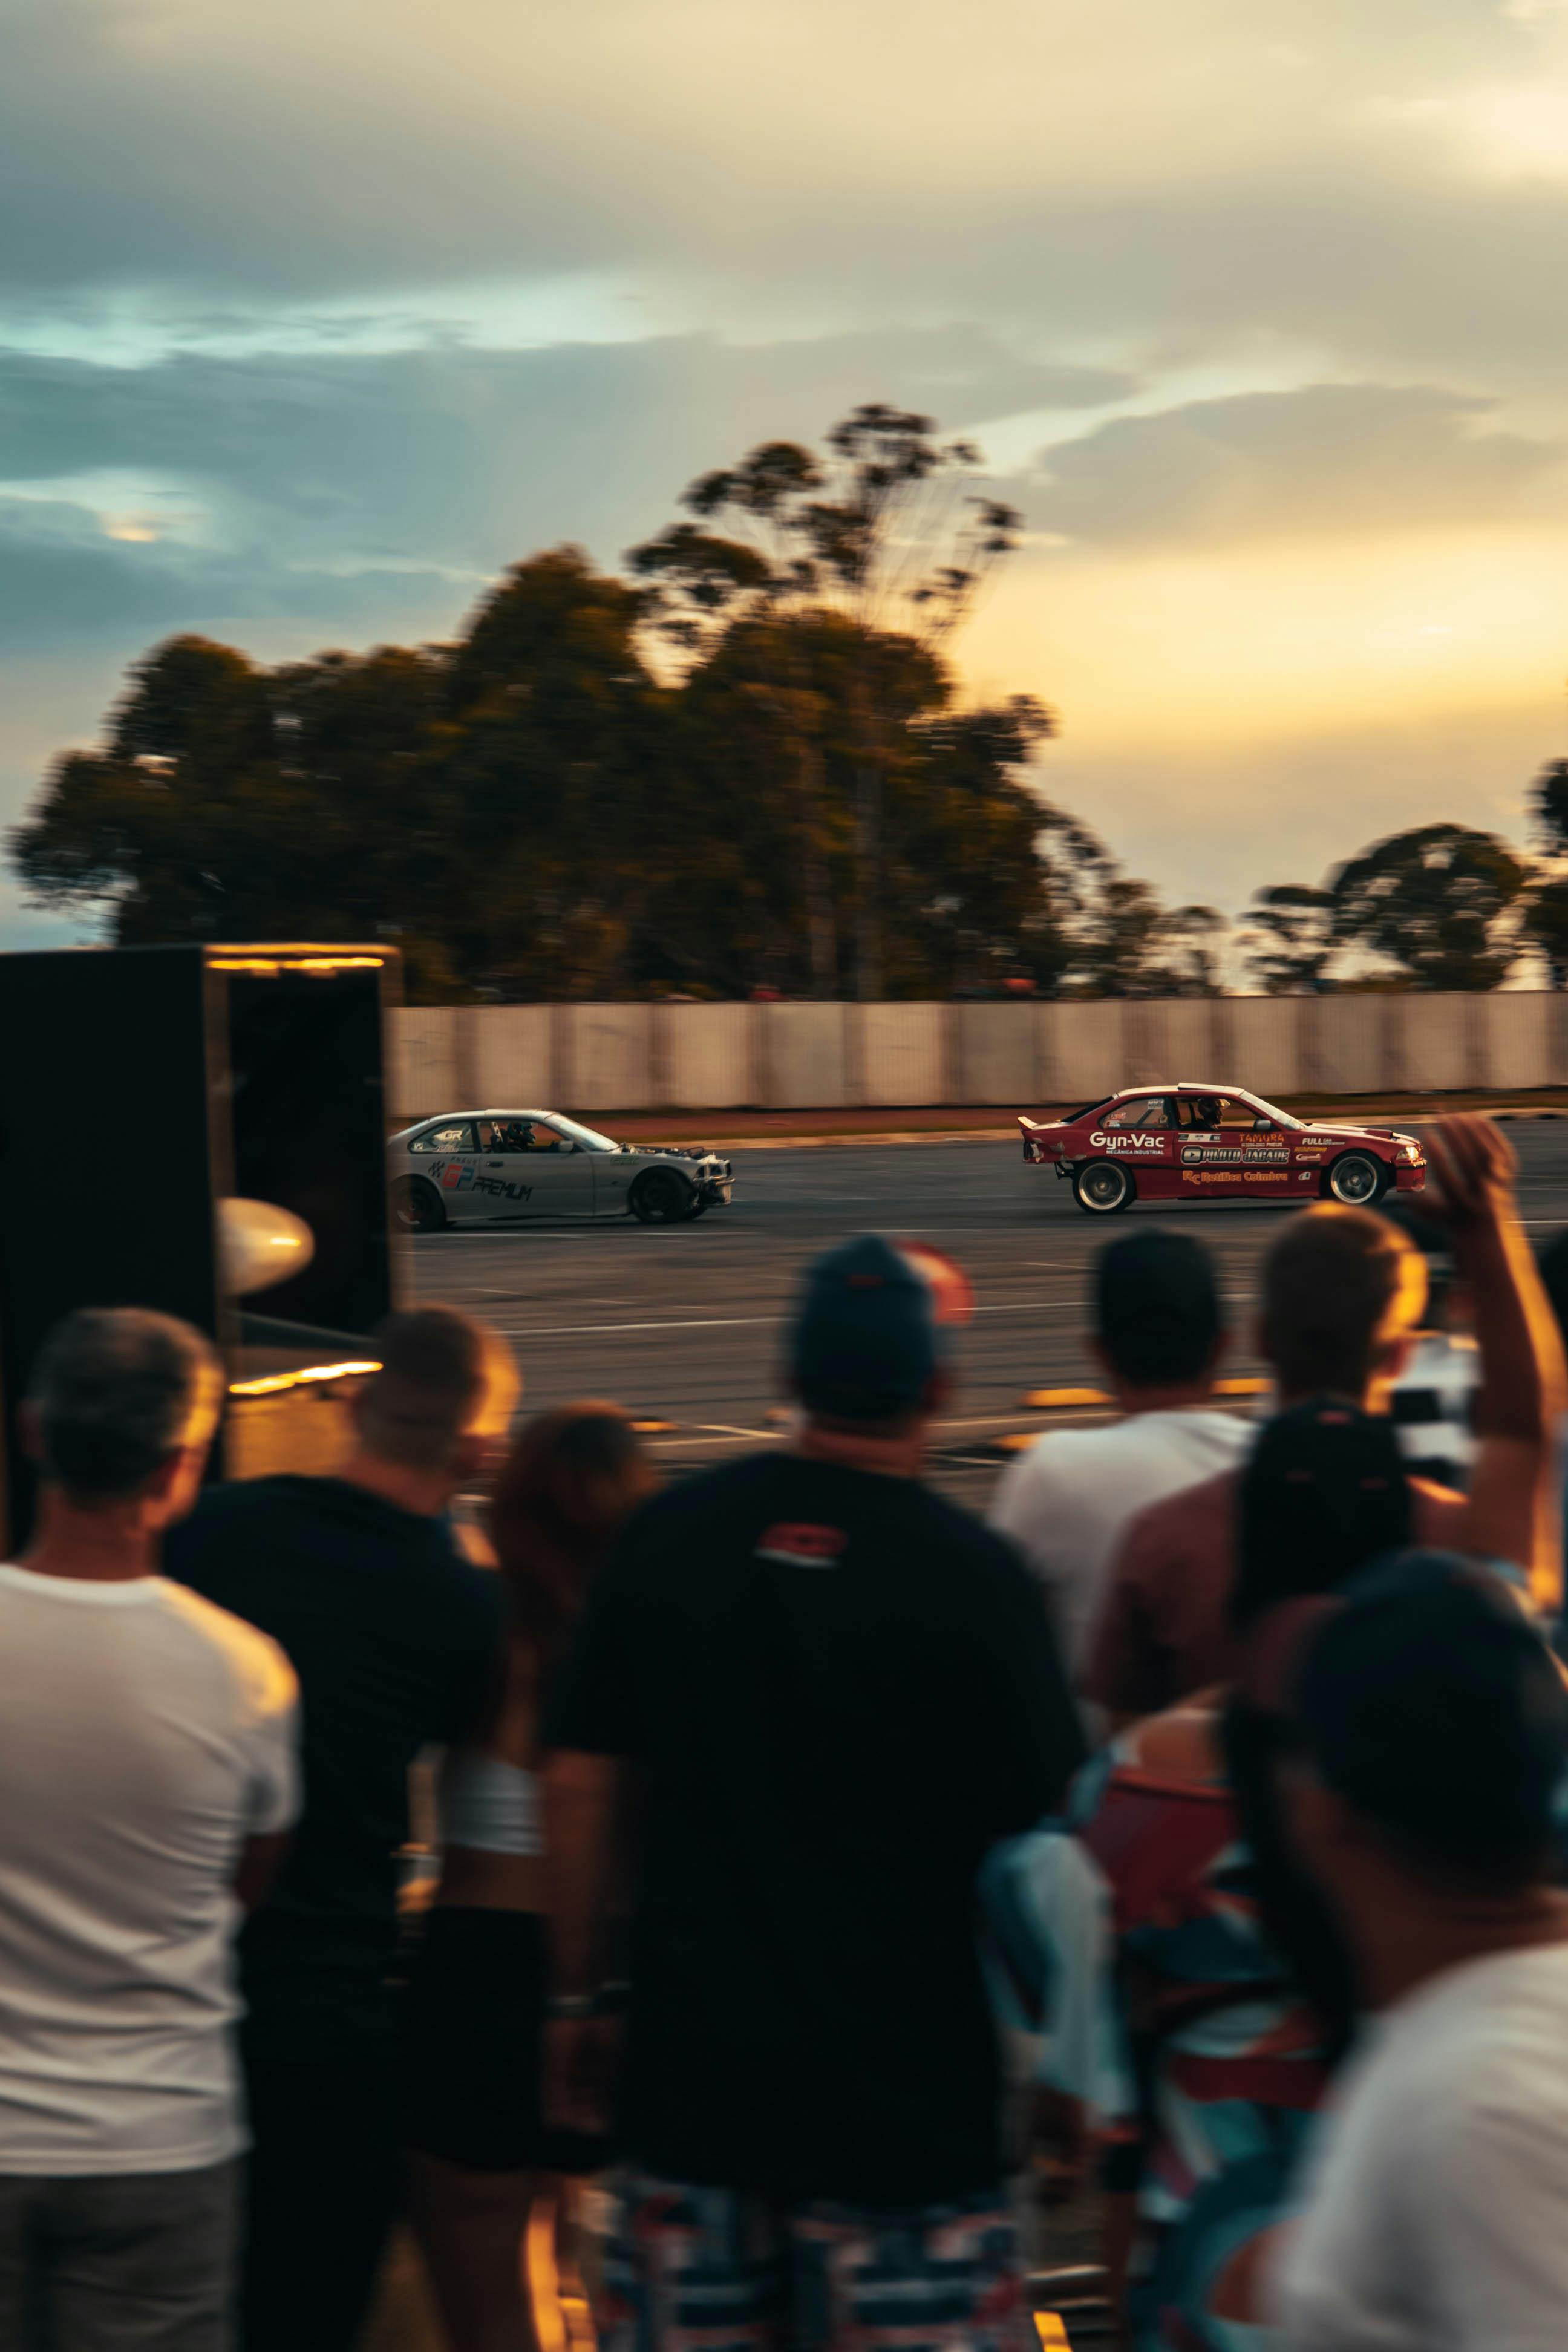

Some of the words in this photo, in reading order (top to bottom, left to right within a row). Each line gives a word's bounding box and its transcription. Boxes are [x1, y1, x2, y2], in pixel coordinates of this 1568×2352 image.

[1089, 1132, 1165, 1149] Gyn-Vac
[1239, 1133, 1285, 1142] TAMURA
[1202, 1148, 1241, 1163] PILOTO
[442, 1163, 475, 1191] GP
